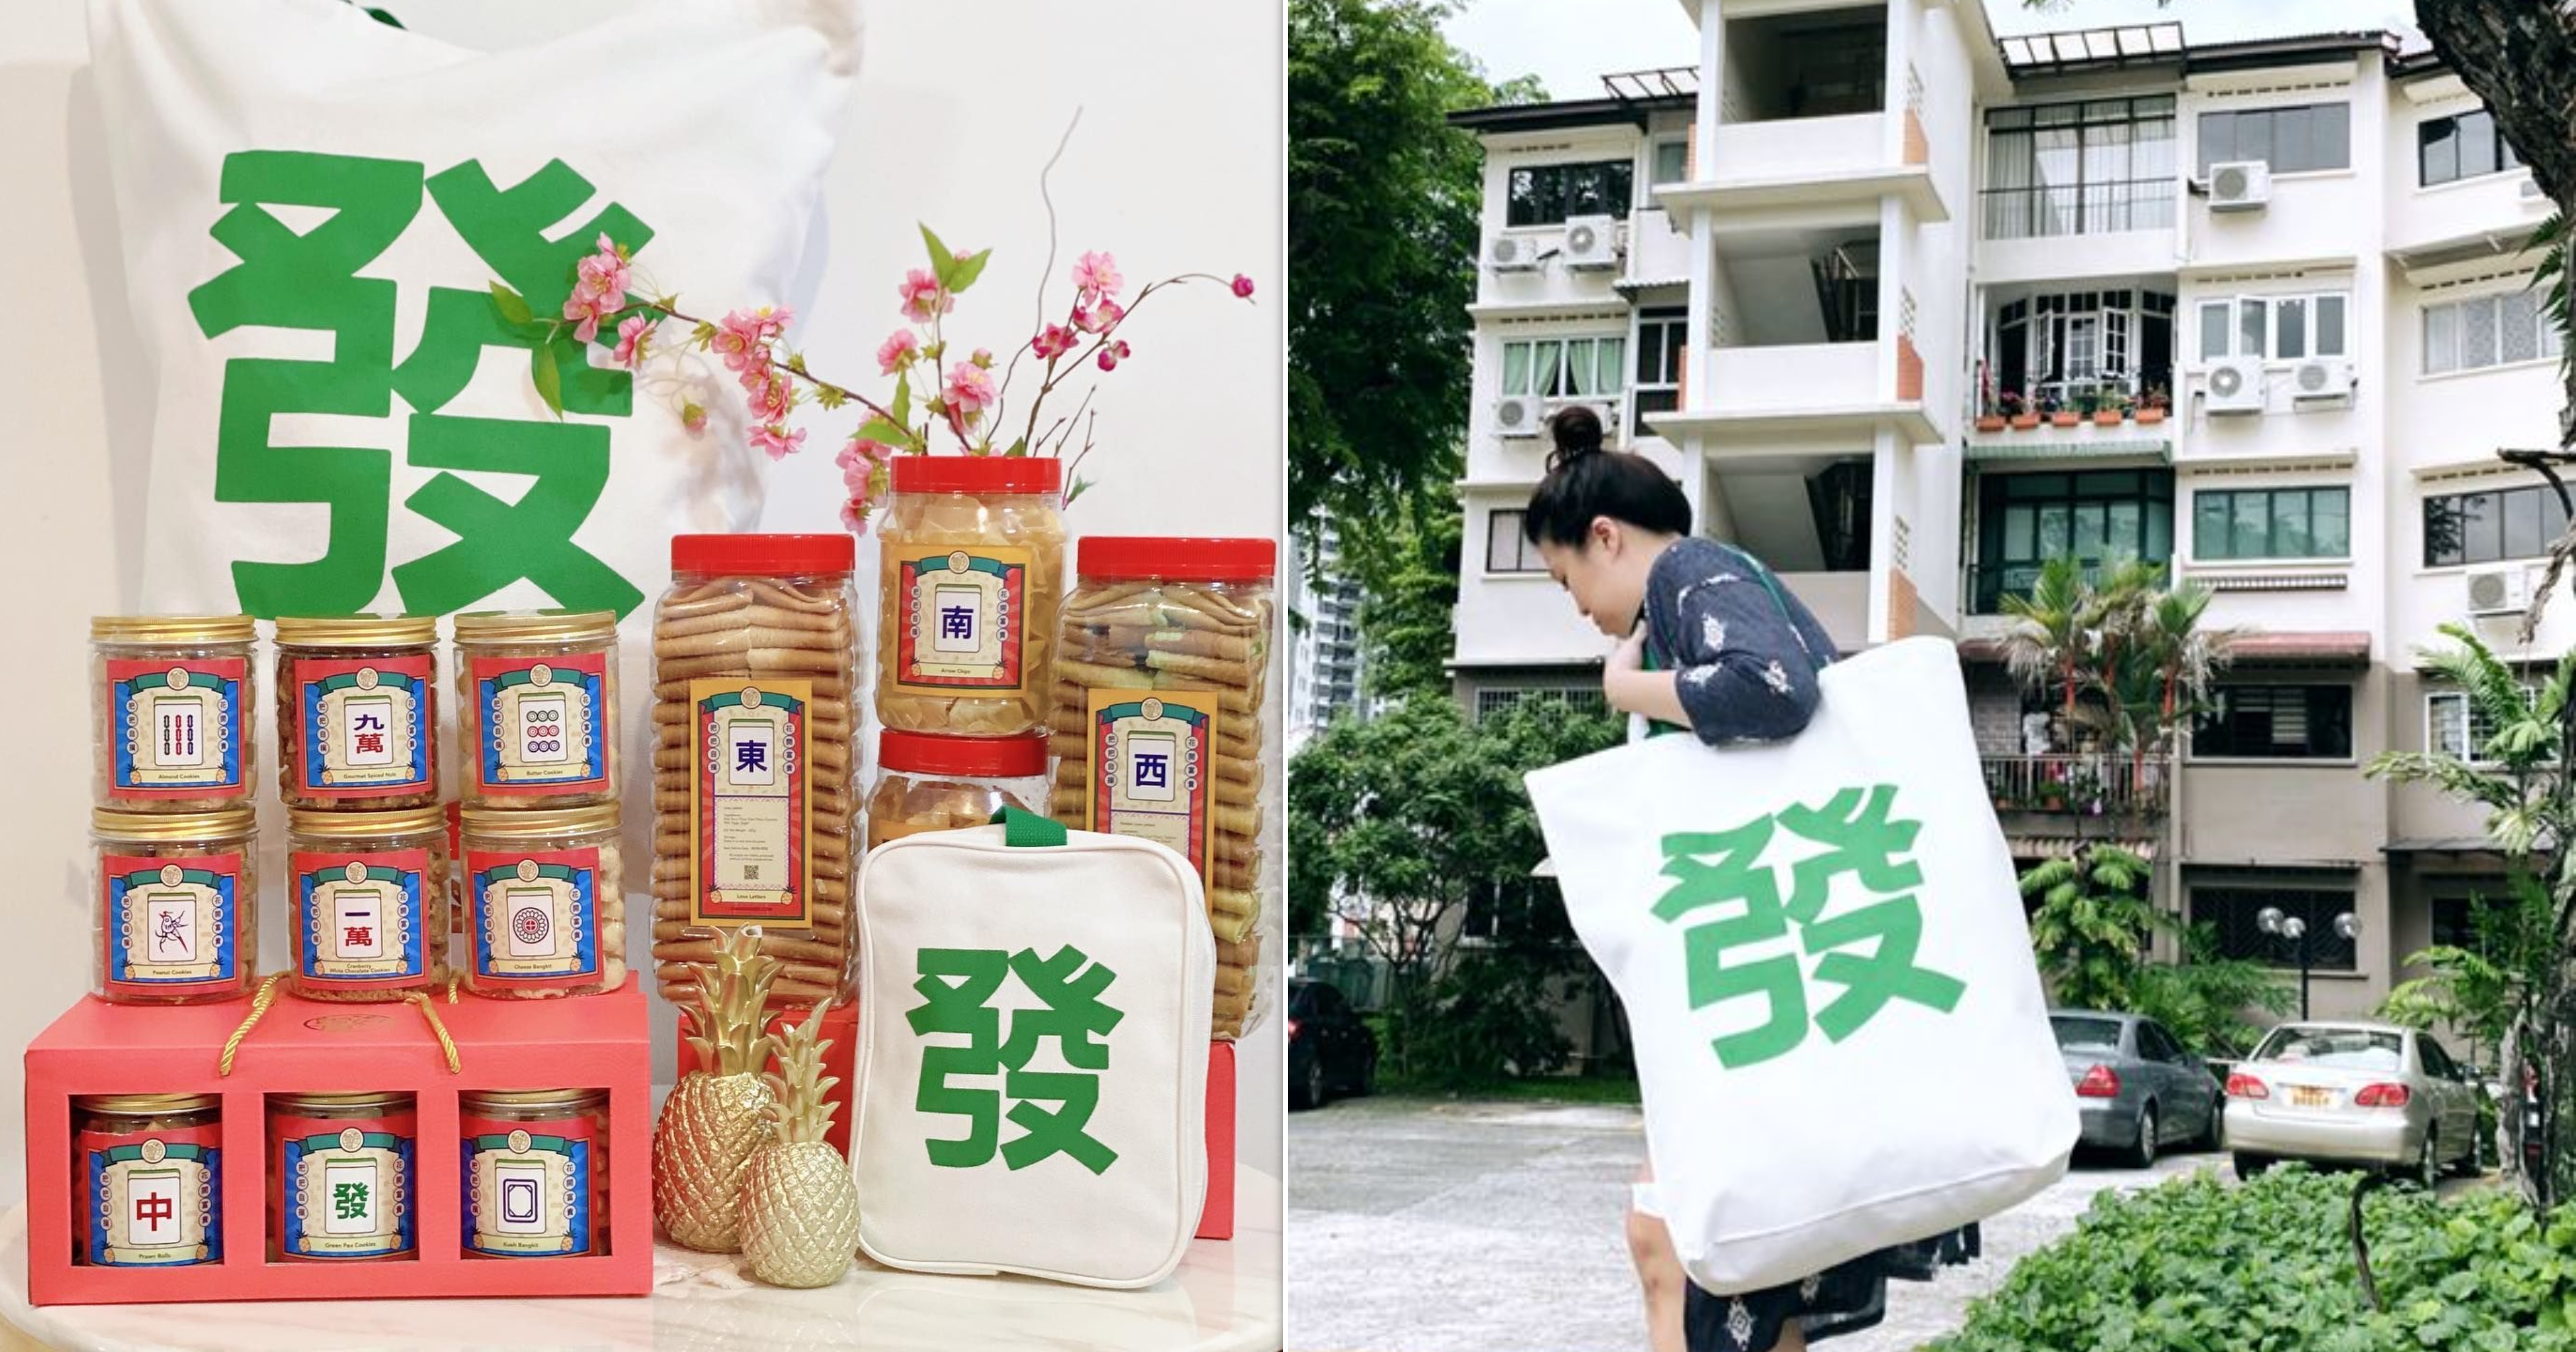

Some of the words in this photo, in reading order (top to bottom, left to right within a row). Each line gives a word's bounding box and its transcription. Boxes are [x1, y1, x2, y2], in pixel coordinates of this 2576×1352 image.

[187, 150, 668, 624] 發
[942, 605, 974, 639] 南
[354, 714, 384, 754] 九萬
[735, 739, 768, 773] 東
[1135, 754, 1168, 787] 西
[343, 912, 373, 947] 一萬
[1650, 784, 1968, 1070] 發
[905, 944, 1125, 1176] 發
[137, 1192, 172, 1232] 中
[333, 1182, 370, 1219] 發
